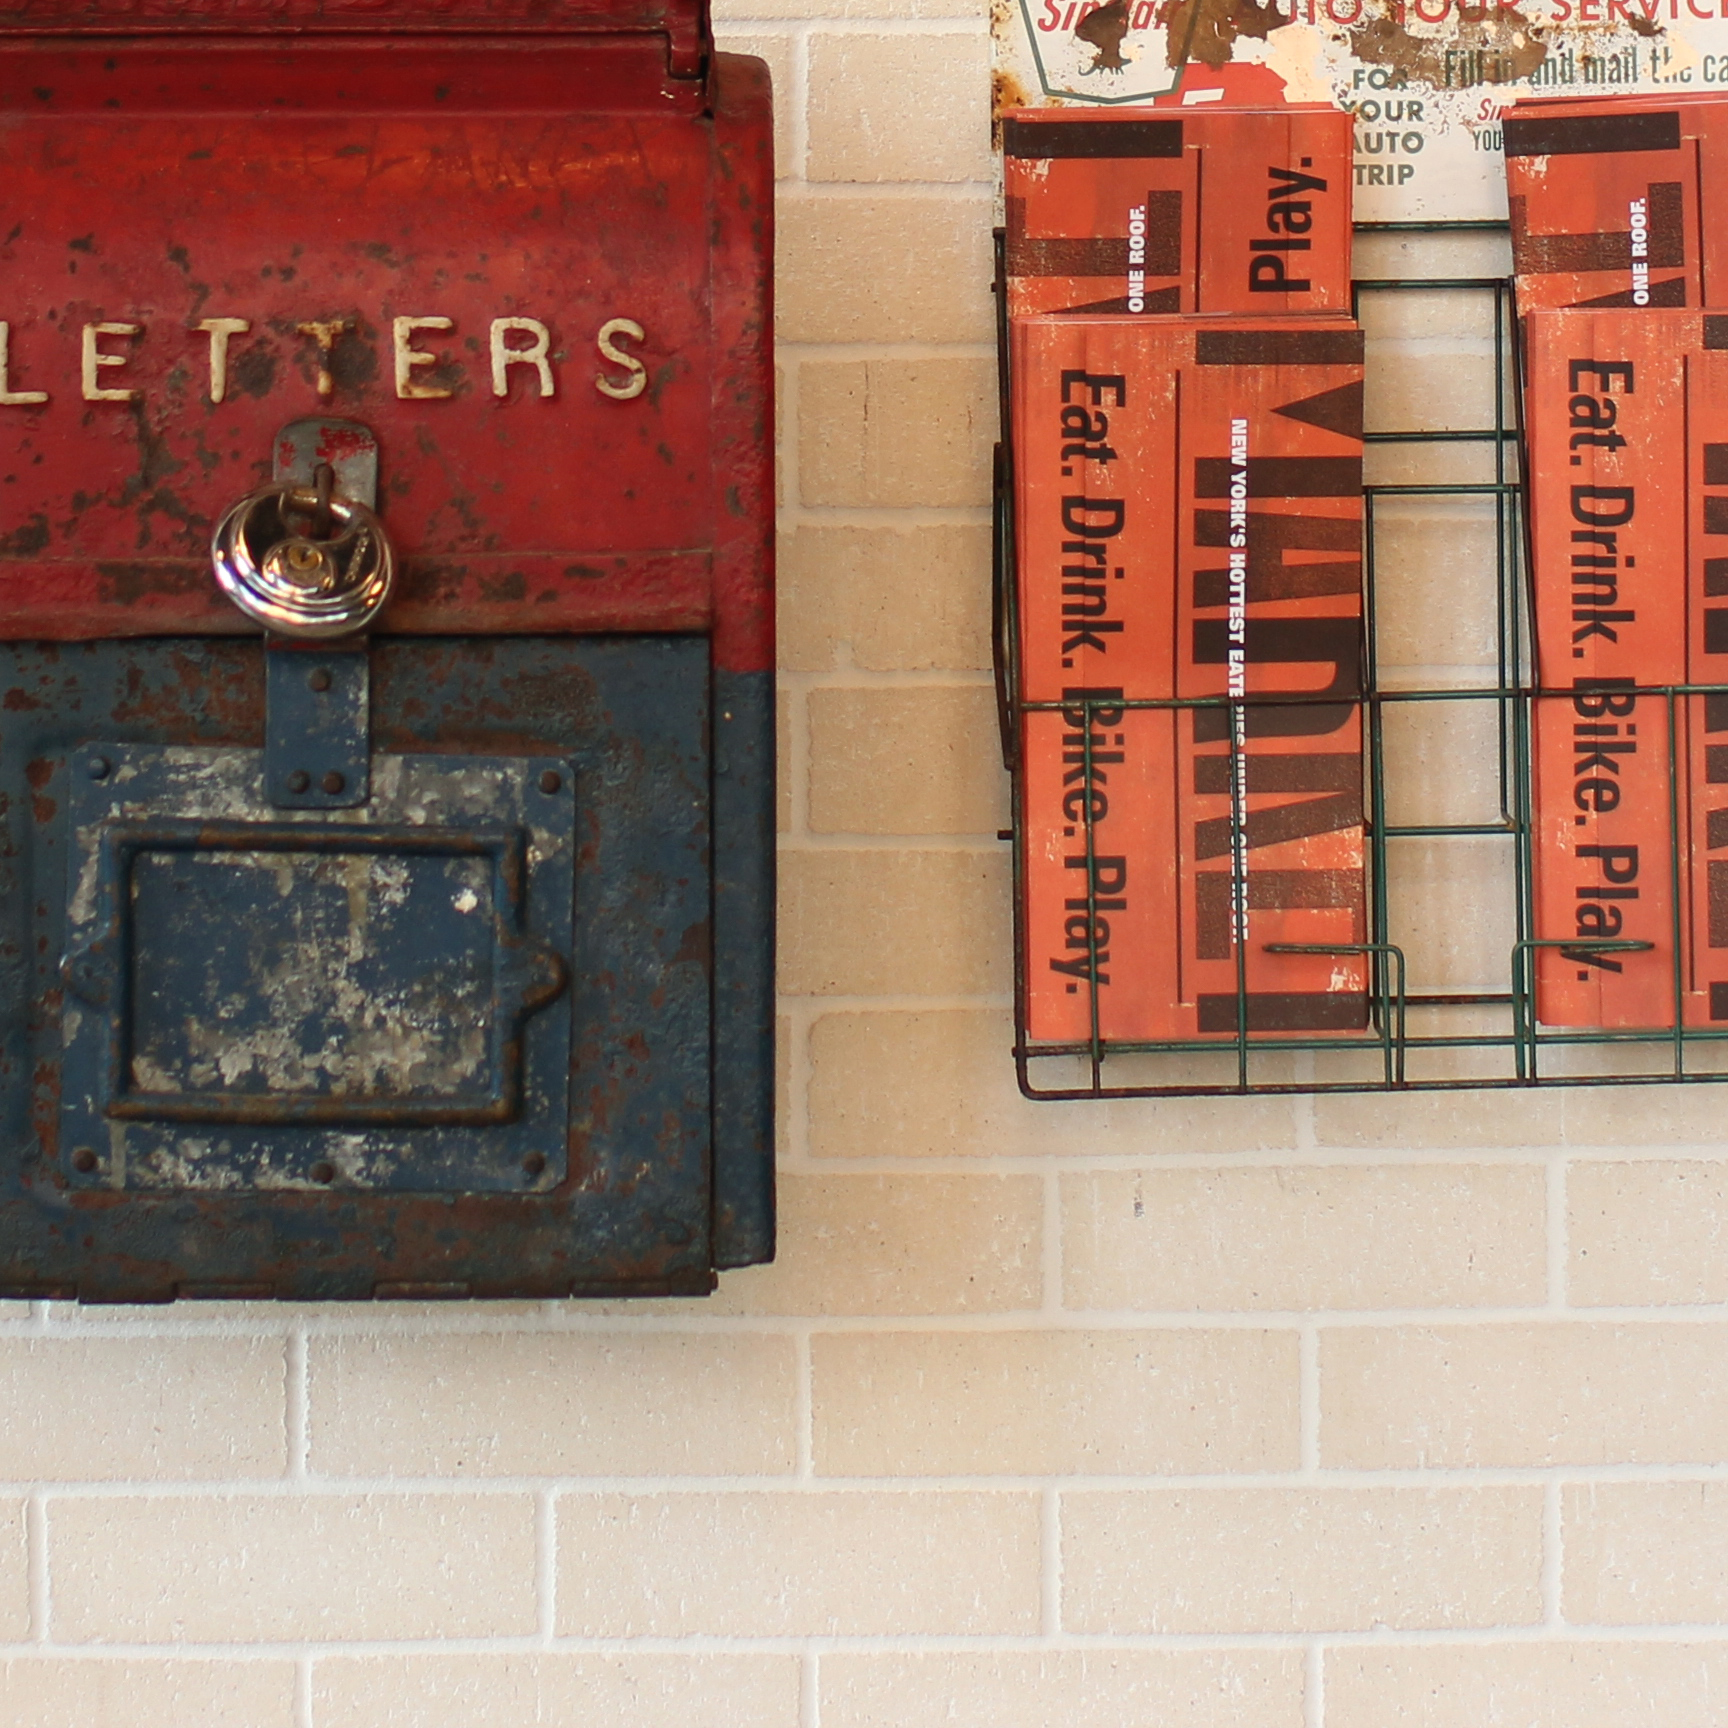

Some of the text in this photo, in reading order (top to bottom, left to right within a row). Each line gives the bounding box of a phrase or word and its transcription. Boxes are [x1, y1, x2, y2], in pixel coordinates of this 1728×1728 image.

[1339, 99, 1425, 122] YOUR
[1353, 68, 1409, 90] FOR
[1583, 45, 1638, 85] mail
[1353, 164, 1416, 186] TRIP
[1126, 204, 1146, 313] ONE ROOF.
[1249, 155, 1327, 294] Play.
[1629, 198, 1649, 306] ONE ROOF.
[1230, 419, 1248, 467] NEW
[1229, 470, 1248, 548] YORK'S
[1228, 553, 1247, 644] HOTTEST
[1049, 368, 1128, 994] Eat. Drink. Bike. Play.
[1228, 649, 1246, 747] EATEIES
[1560, 358, 1640, 983] Eat. Drink. Bike. Play.
